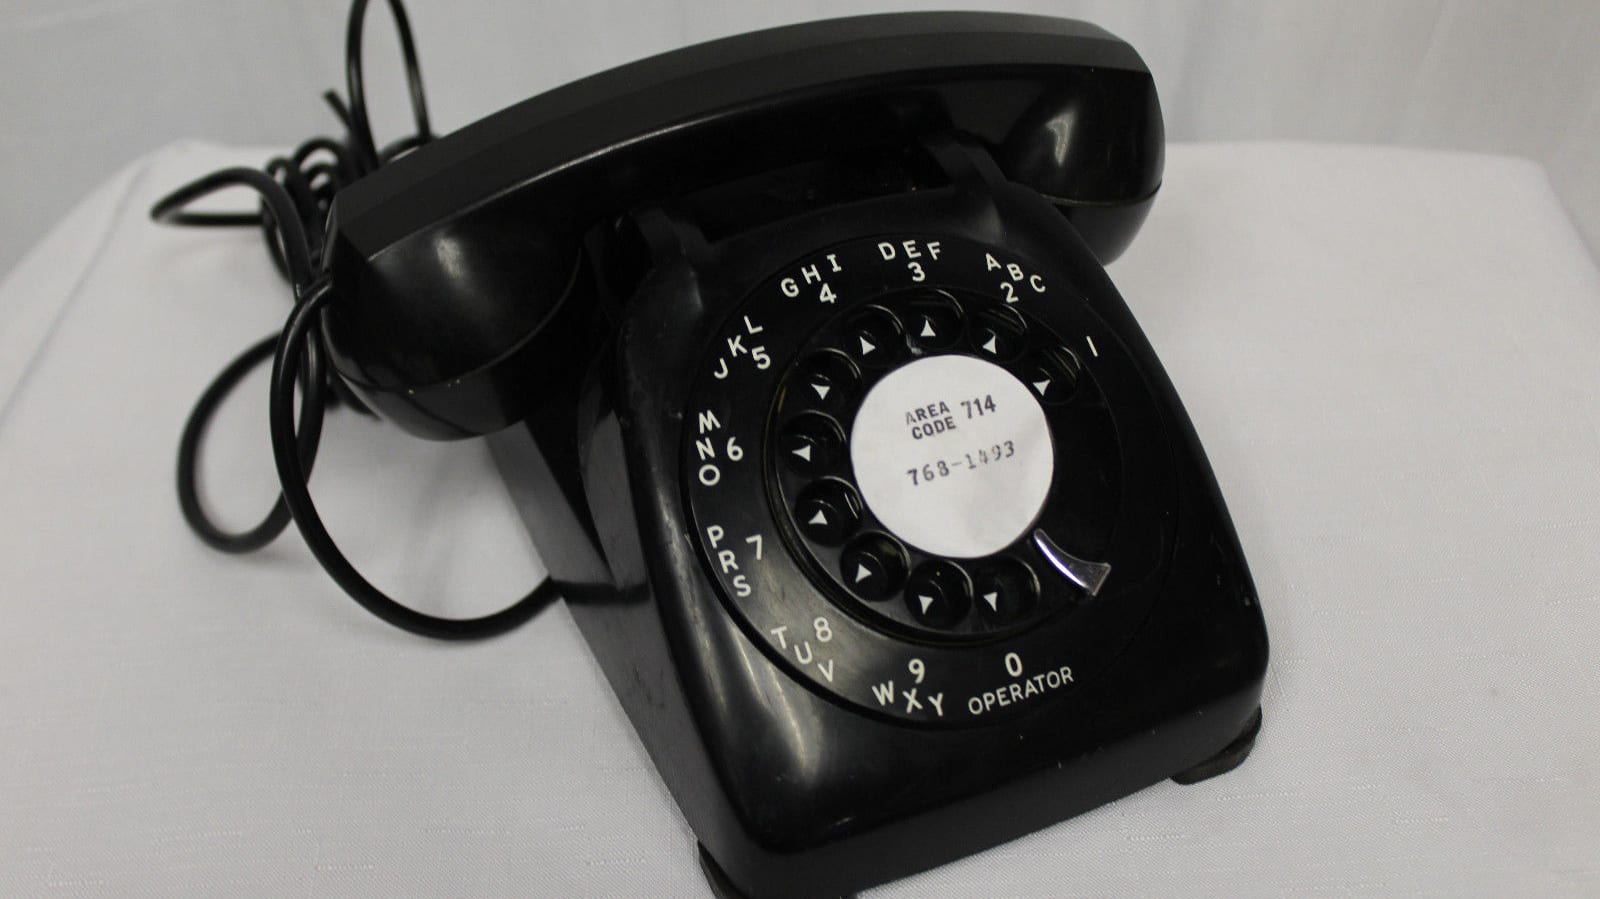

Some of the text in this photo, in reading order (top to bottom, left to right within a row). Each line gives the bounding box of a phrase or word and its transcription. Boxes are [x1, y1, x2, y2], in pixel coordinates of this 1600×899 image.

[877, 239, 942, 261] DEF
[780, 253, 843, 298] GHI
[906, 261, 926, 283] 3
[984, 252, 1048, 294] ABC
[818, 282, 837, 304] 4
[1000, 281, 1020, 304] 2
[750, 345, 772, 371] 5
[905, 394, 997, 425] AREA 714
[911, 416, 957, 440] CODE
[726, 437, 744, 462] 6
[744, 533, 764, 562] 7
[813, 615, 834, 644] 8
[907, 657, 926, 685] 9
[870, 680, 945, 717] WXY
[967, 664, 1075, 716] OPERATOR
